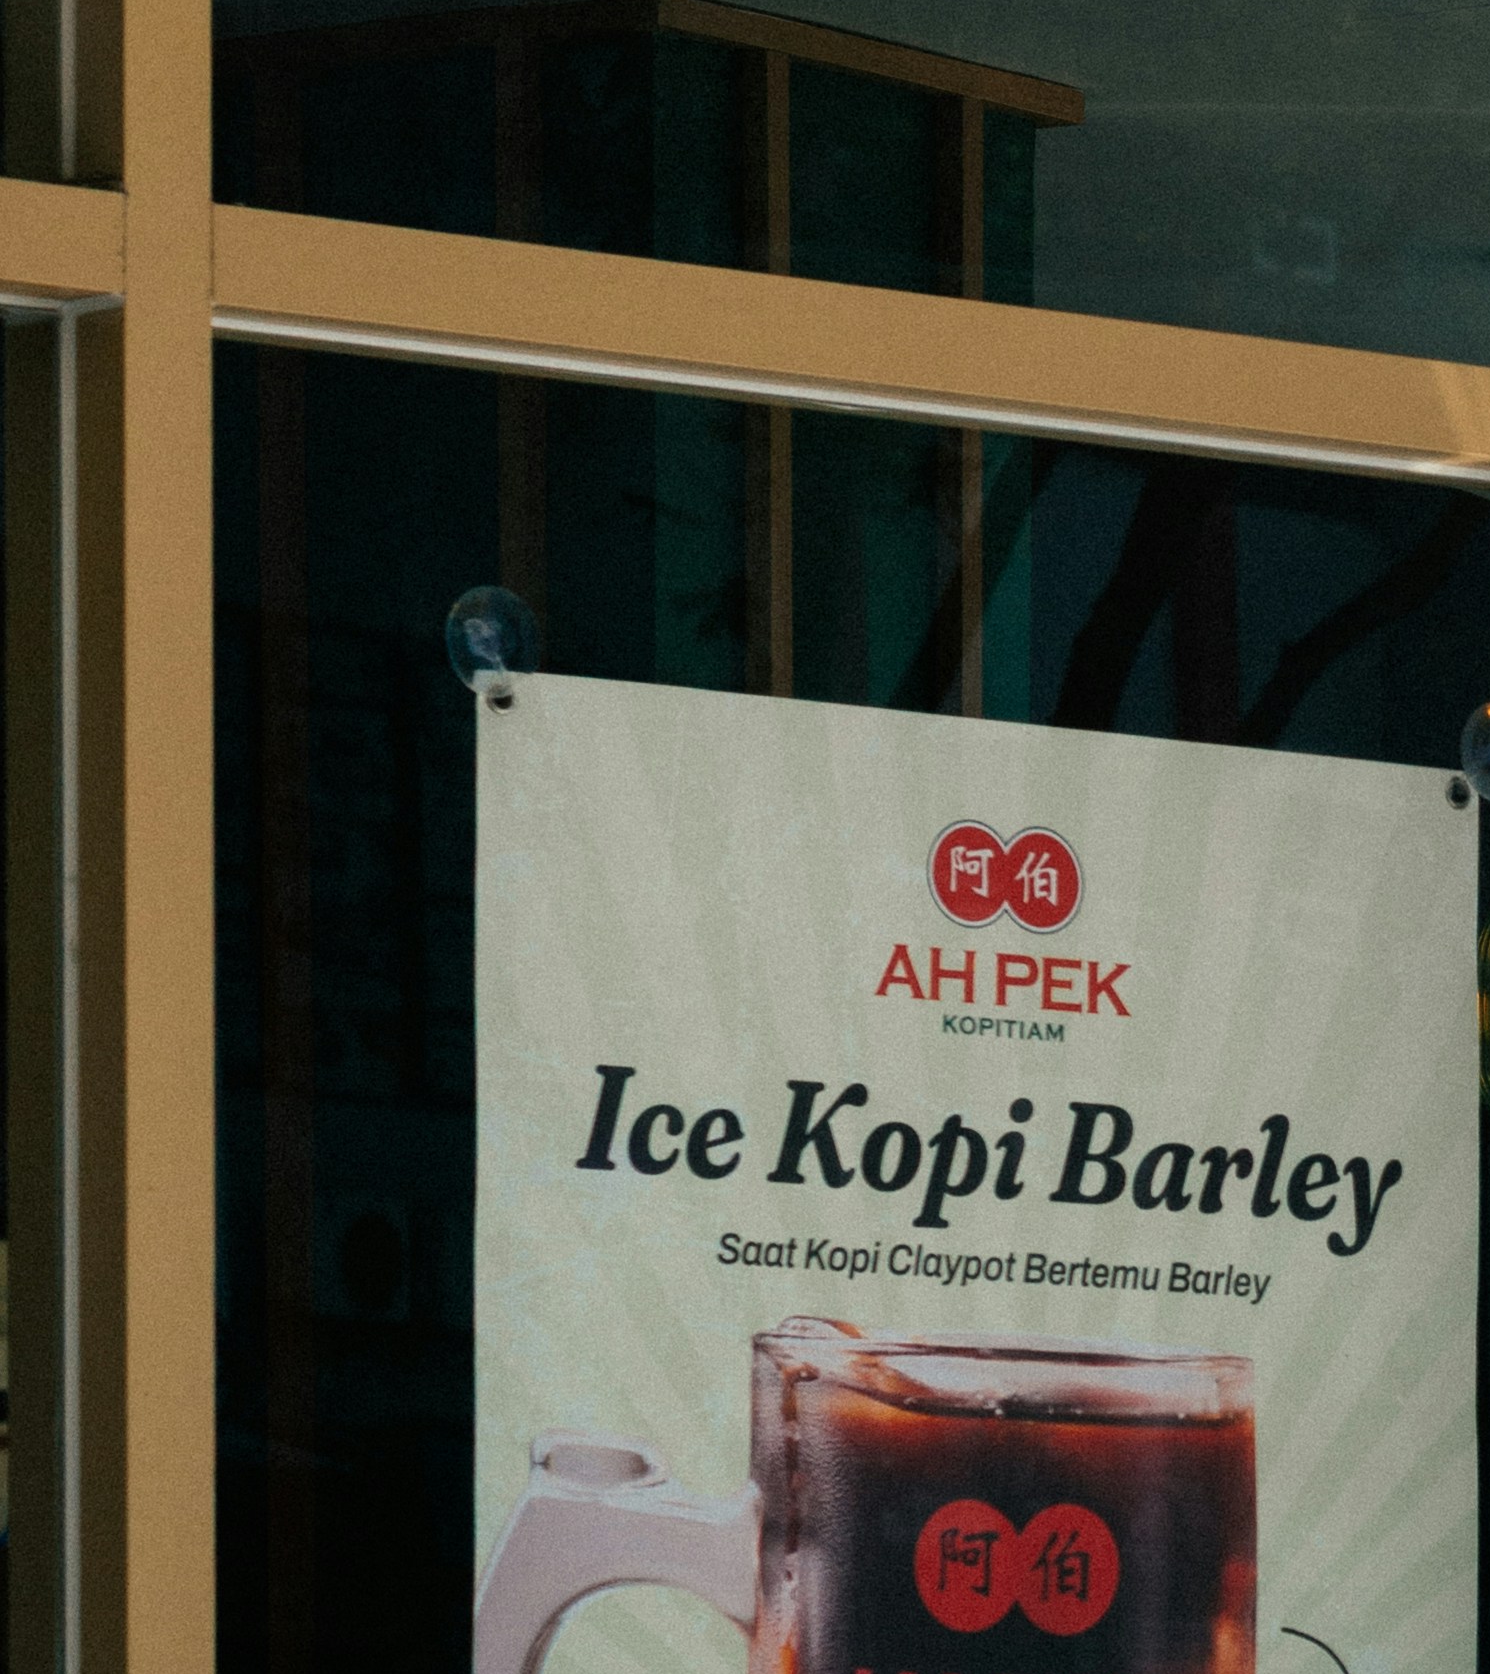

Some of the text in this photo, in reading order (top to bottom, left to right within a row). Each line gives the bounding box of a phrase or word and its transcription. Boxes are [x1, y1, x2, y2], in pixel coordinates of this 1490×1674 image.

[949, 846, 1058, 907] 阿伯
[875, 943, 1132, 1017] AH PEK
[942, 1014, 1065, 1042] KOPITIAM
[575, 1064, 1403, 1257] Ice Kopi Barley
[717, 1233, 1272, 1305] Saat Kopi Claypot Bertemu Barley
[938, 1528, 1092, 1604] 阿伯
